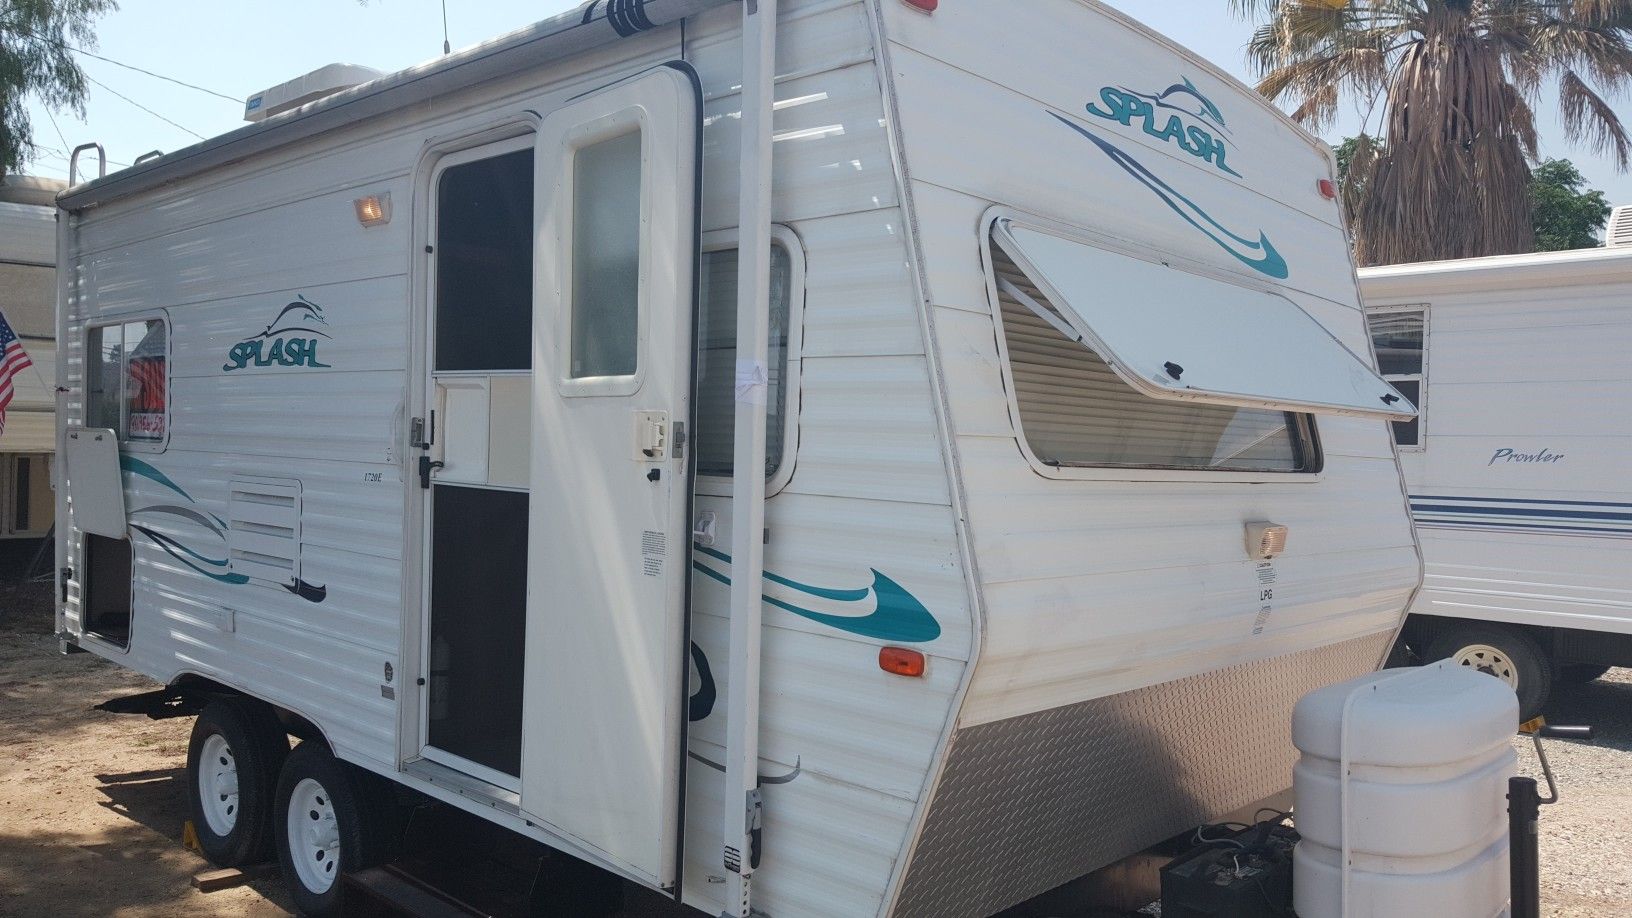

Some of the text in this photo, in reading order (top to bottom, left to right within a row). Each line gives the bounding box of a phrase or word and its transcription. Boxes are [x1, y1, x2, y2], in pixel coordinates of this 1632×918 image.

[1086, 87, 1243, 179] SPLASH
[223, 338, 331, 371] SPLASH
[1488, 448, 1565, 466] Prowler
[1260, 589, 1273, 601] LPG
